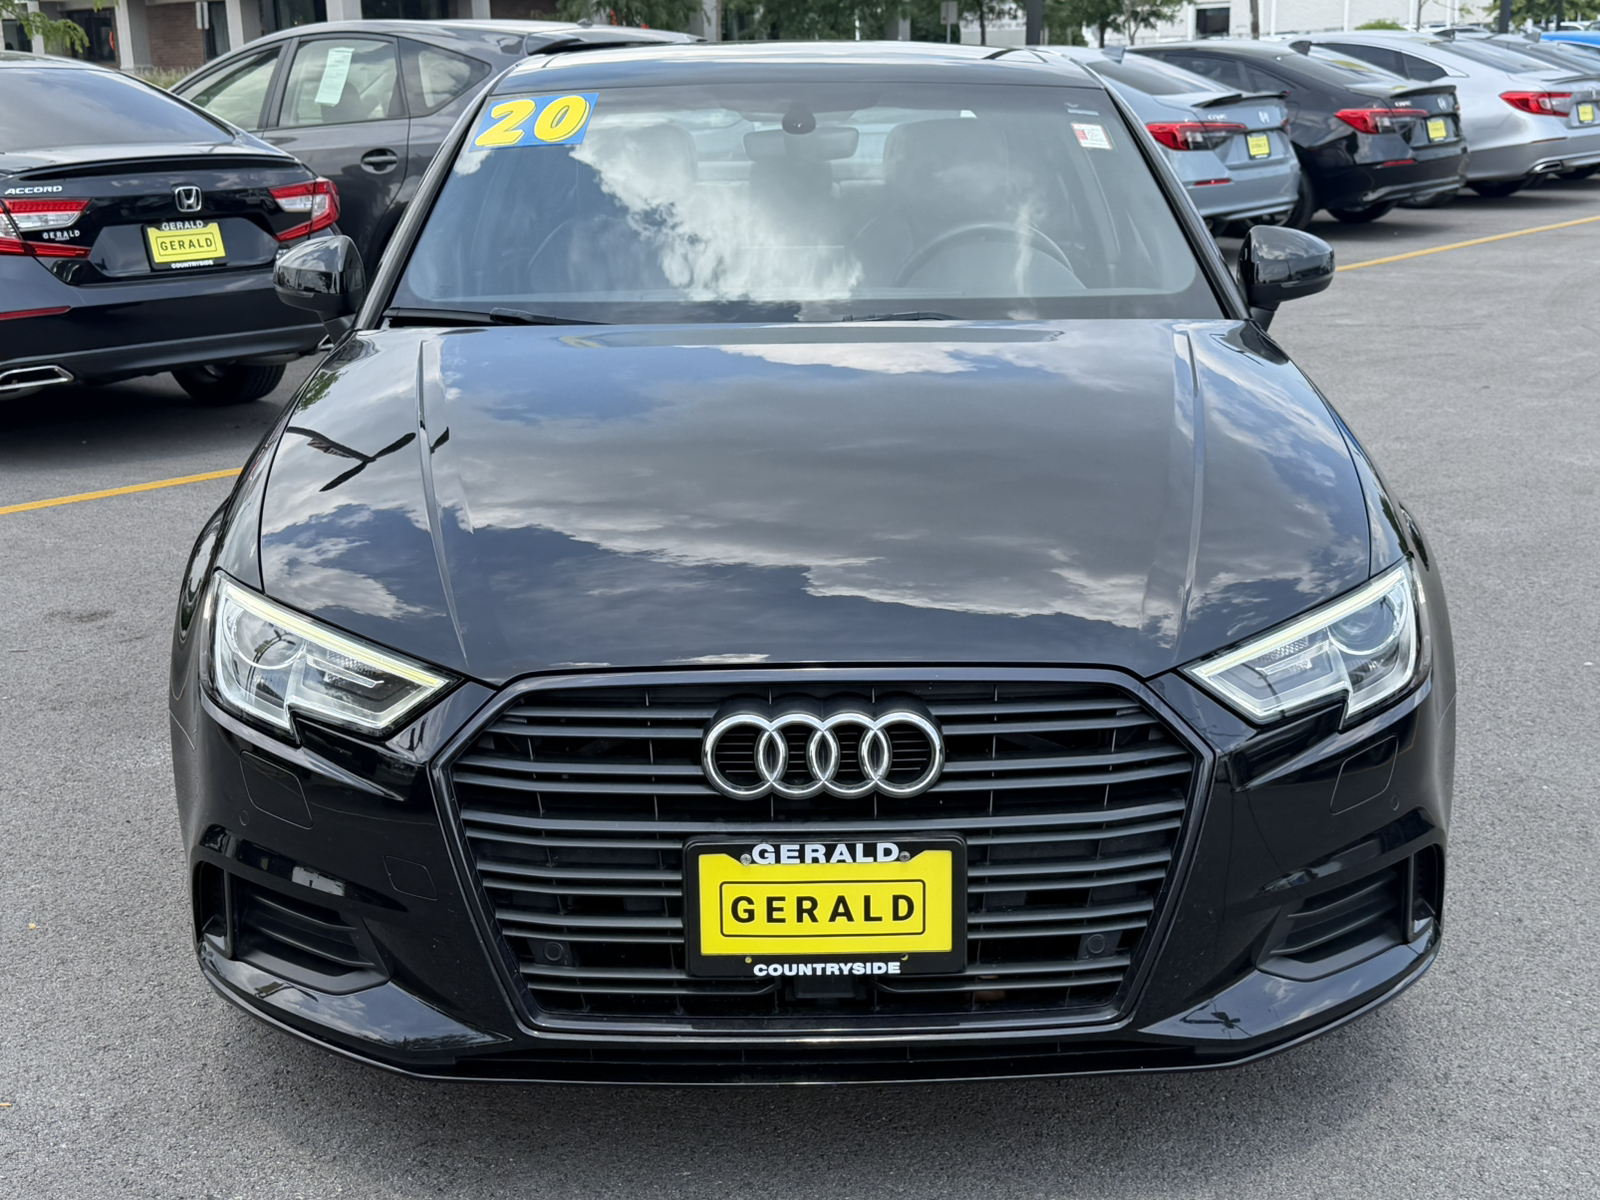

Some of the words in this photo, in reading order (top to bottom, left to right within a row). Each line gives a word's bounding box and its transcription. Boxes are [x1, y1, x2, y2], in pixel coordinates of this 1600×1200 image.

[475, 95, 591, 147] 20
[4, 185, 63, 195] ACCORD
[162, 220, 204, 231] GERALD
[42, 229, 81, 239] GERALD
[160, 237, 213, 251] GERALD
[751, 842, 900, 865] GERALD
[730, 894, 915, 924] GERALD
[753, 961, 901, 977] COUNTRYSIDE
